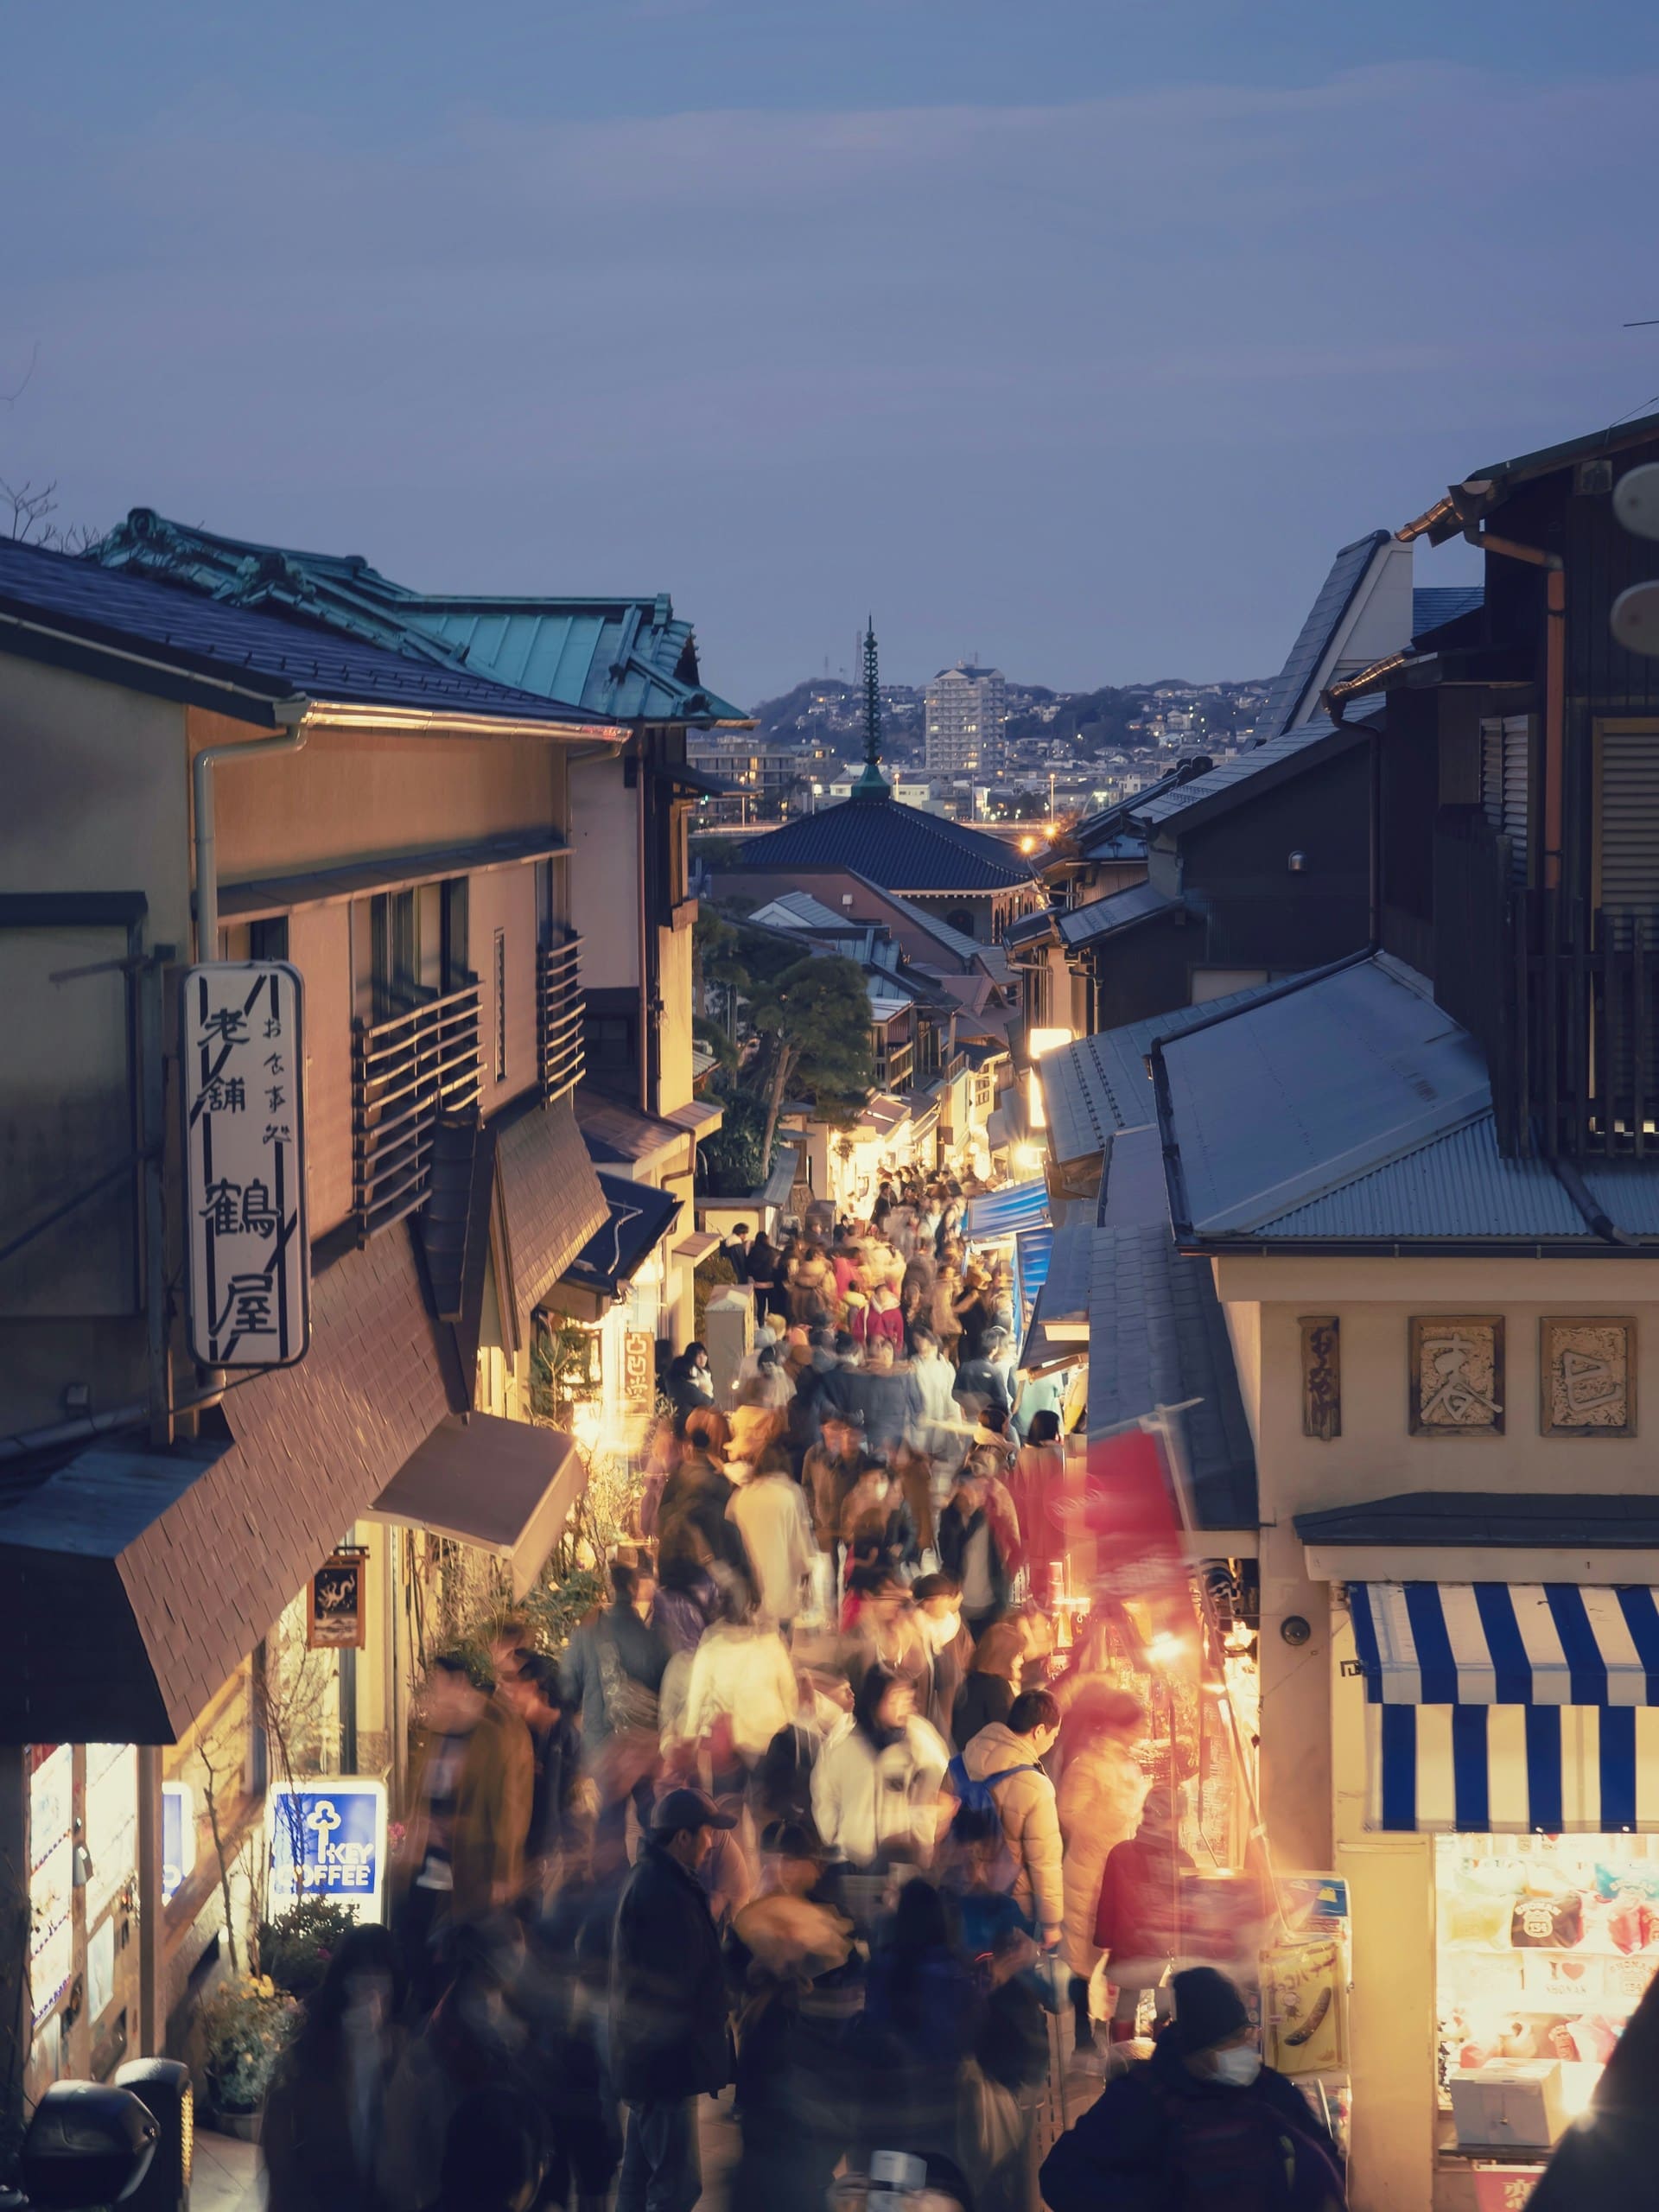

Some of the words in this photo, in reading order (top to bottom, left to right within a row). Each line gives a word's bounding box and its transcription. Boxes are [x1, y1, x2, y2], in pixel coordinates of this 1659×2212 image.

[263, 1018, 292, 1145] お食事処
[327, 1842, 375, 1865] KEY
[276, 1864, 371, 1888] COFFEE
